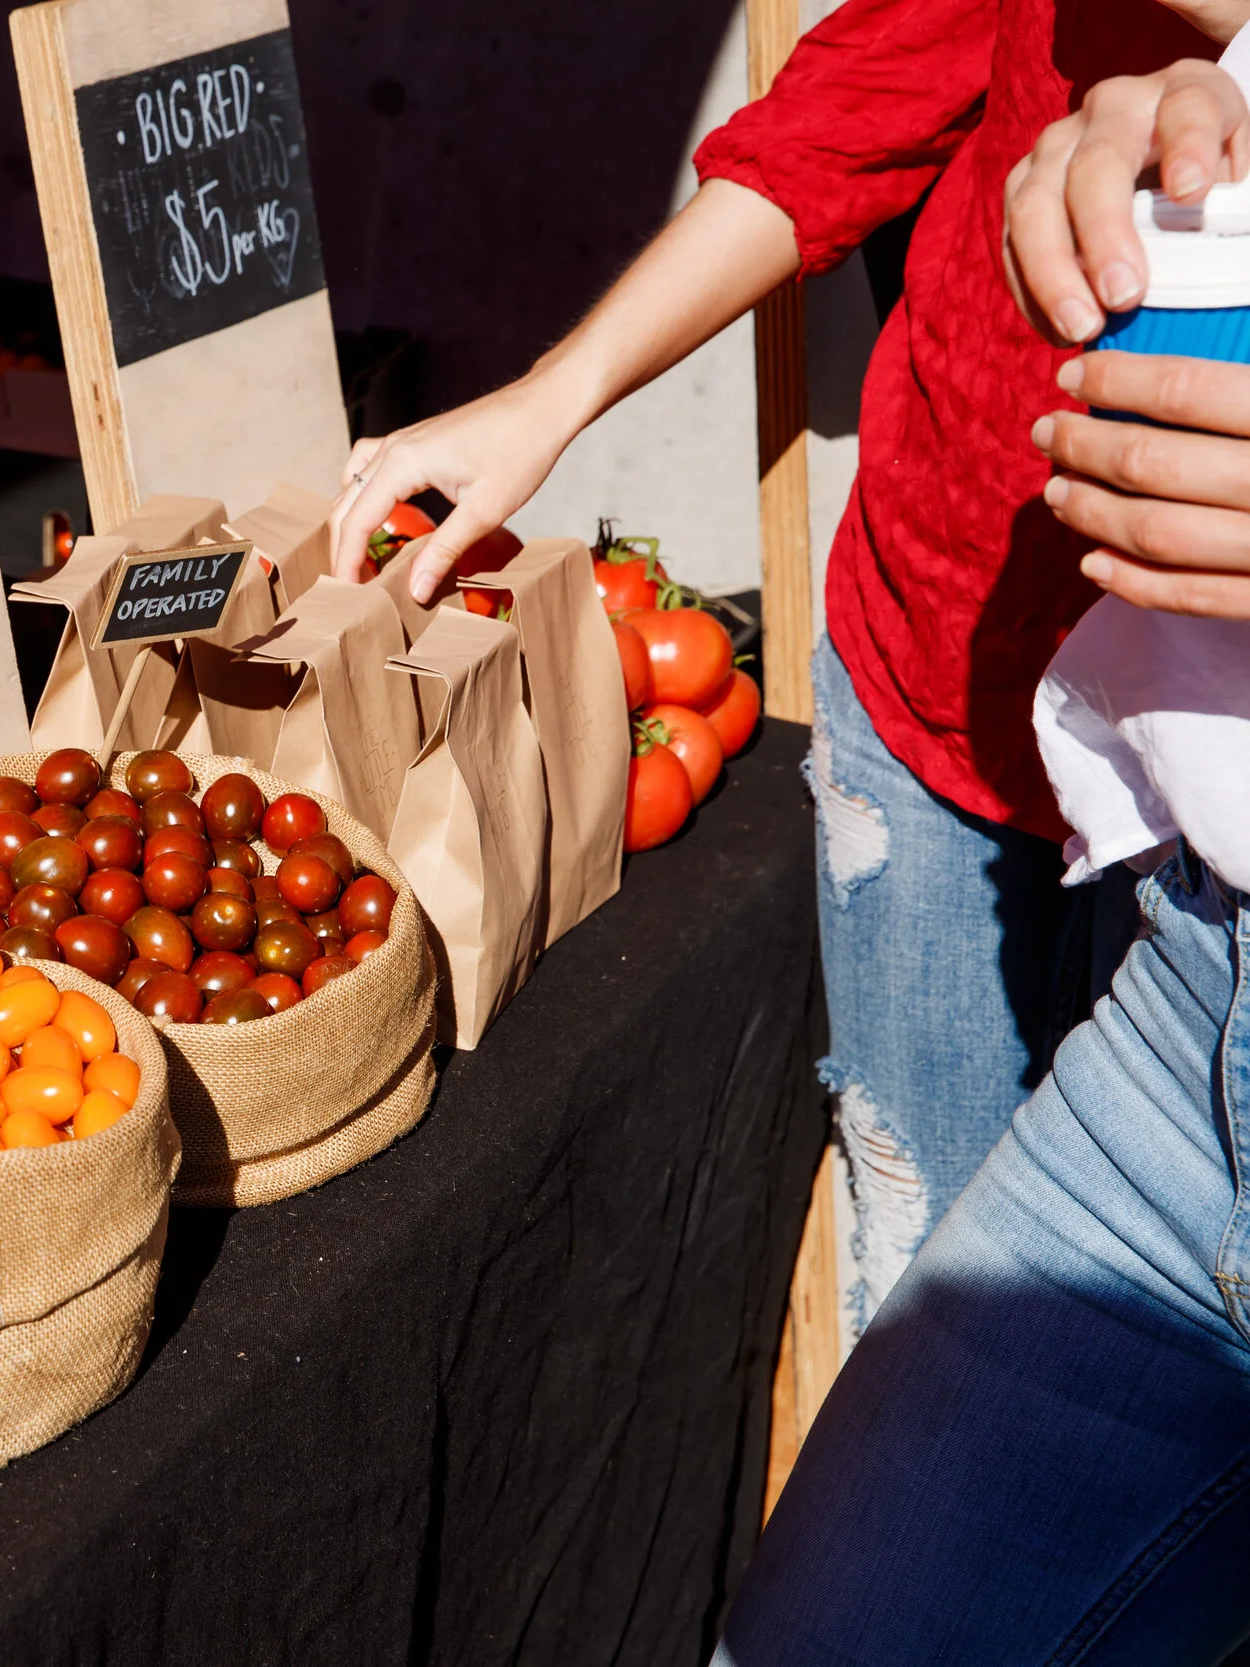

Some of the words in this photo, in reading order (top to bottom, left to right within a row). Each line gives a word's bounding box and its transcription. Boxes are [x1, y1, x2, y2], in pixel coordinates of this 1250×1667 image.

[136, 79, 193, 164] BIG
[197, 64, 250, 147] RED
[165, 179, 231, 296] $5
[232, 229, 257, 275] per
[257, 199, 285, 248] KG
[117, 588, 226, 620] OPERATED
[129, 553, 231, 591] FAMILY
